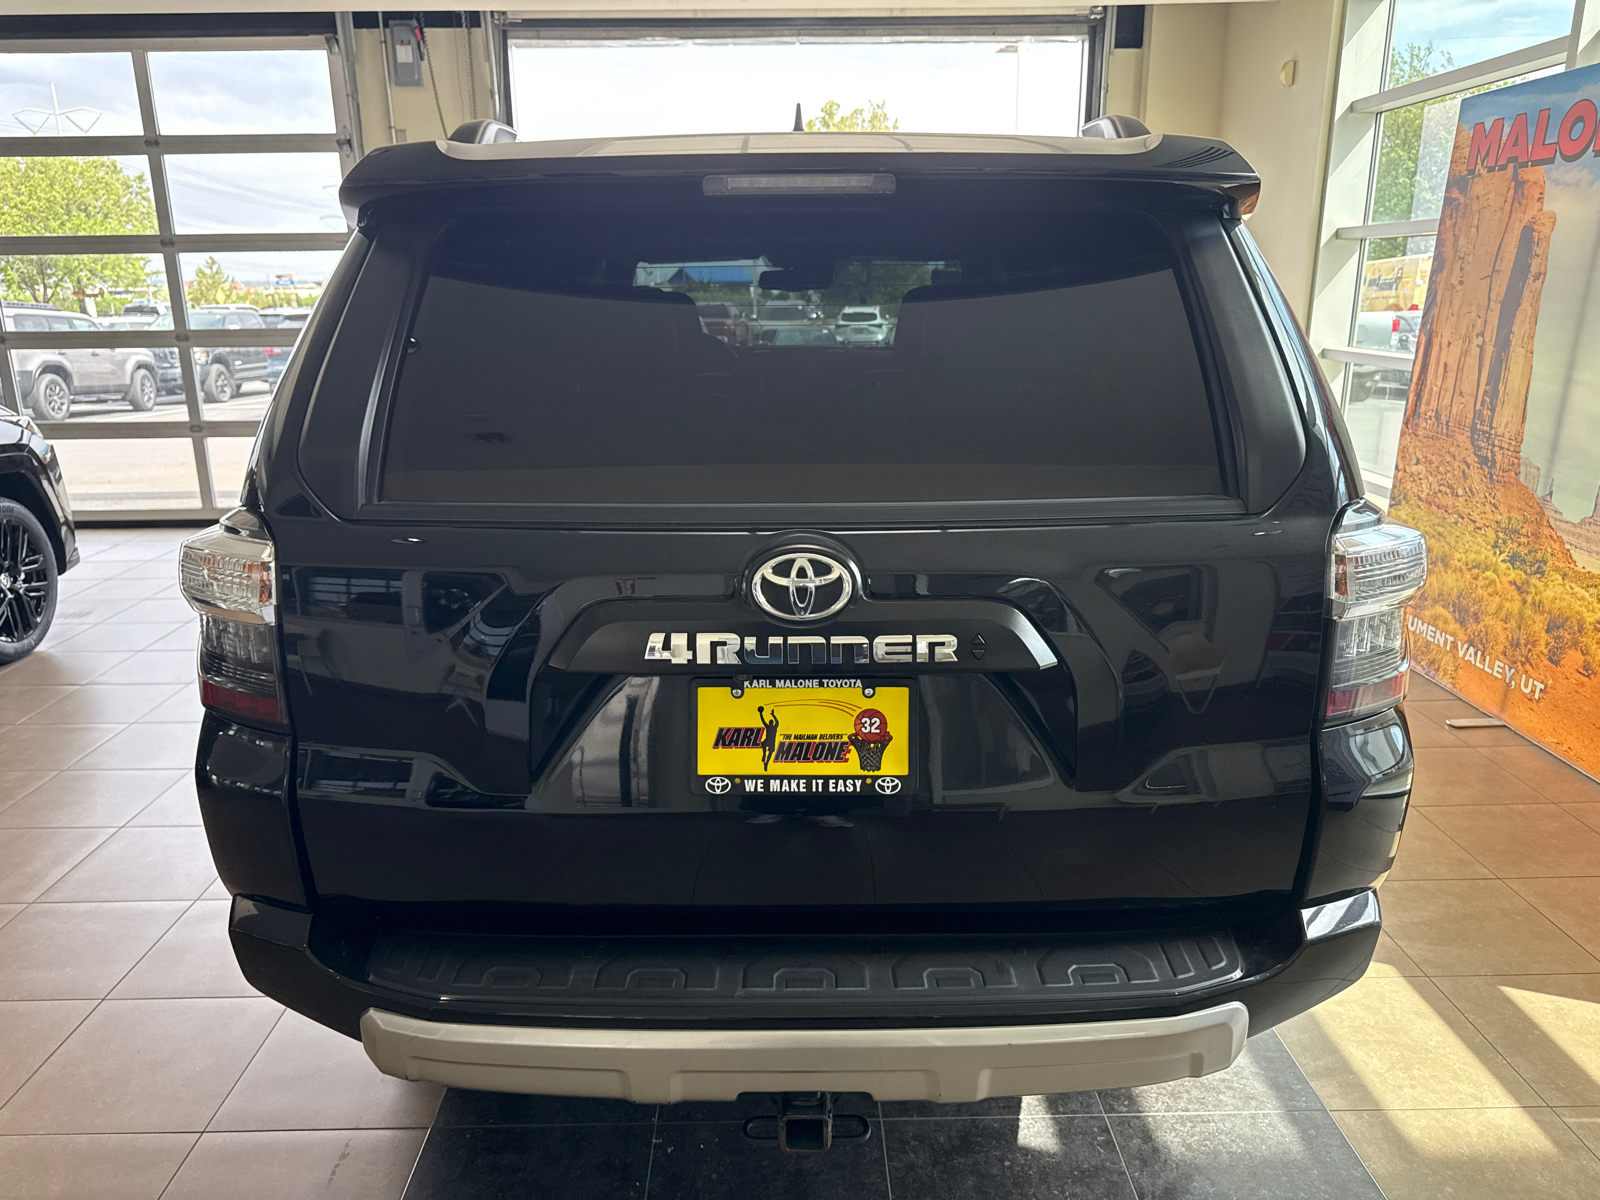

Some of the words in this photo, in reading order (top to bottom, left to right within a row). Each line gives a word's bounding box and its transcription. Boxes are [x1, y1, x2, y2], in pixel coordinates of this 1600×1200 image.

[1466, 98, 1600, 176] MALO
[1407, 613, 1454, 651] UMENT
[1457, 640, 1516, 690] VALLEY,
[1520, 673, 1545, 700] UT
[743, 679, 773, 688] KARL
[775, 679, 820, 688] MALONE
[822, 679, 863, 688] TOYOTA
[861, 717, 881, 734] 32
[713, 727, 765, 749] KARL
[793, 733, 818, 741] MAILMAN
[773, 741, 851, 763] MALONE
[744, 779, 765, 792] WE
[769, 779, 807, 792] MAKE
[812, 779, 824, 792] IT
[828, 779, 862, 792] EASY
